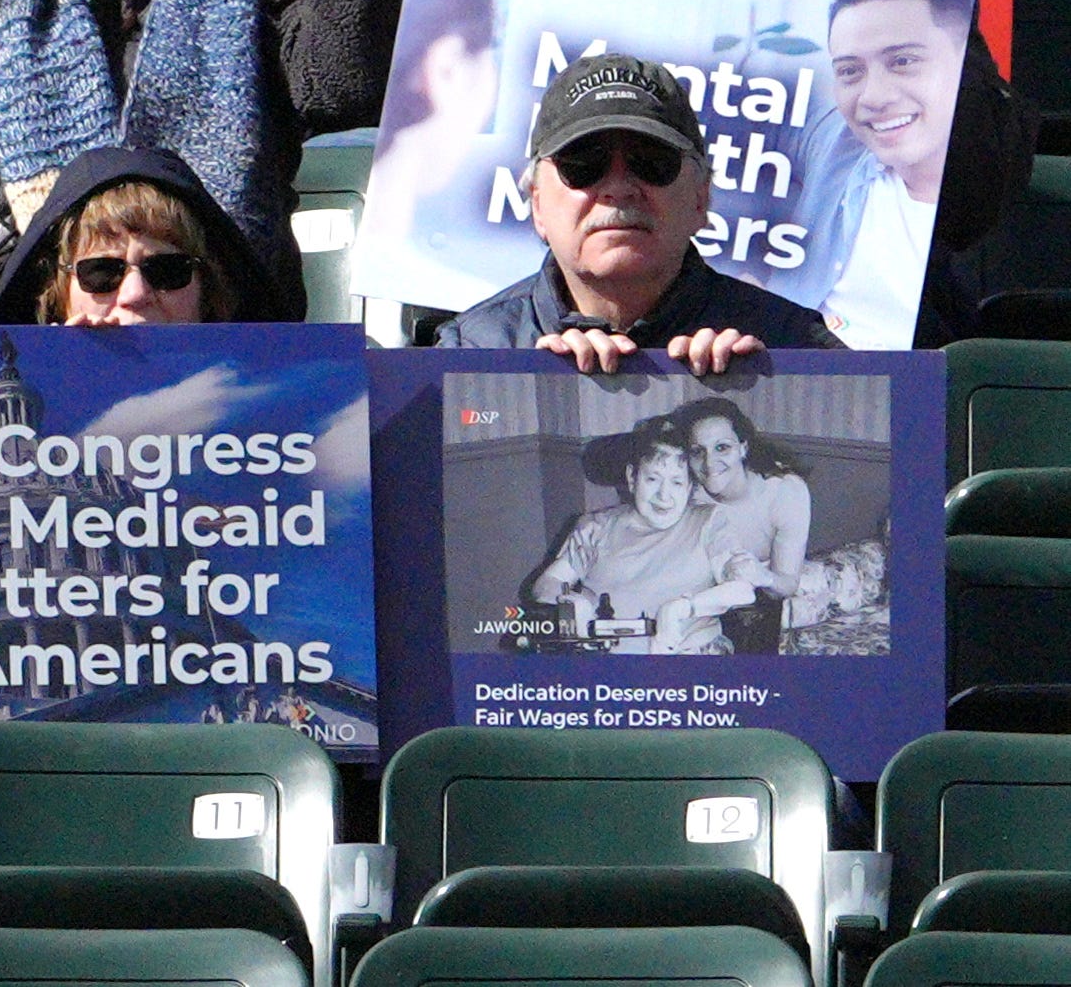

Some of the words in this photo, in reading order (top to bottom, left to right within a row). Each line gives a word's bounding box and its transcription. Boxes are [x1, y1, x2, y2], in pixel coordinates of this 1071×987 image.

[532, 31, 814, 128] Mntal
[487, 166, 808, 269] Mers
[468, 411, 500, 424] DSP
[11, 489, 326, 548] Medicaid
[181, 560, 279, 617] for
[473, 620, 555, 634] JAWONIO
[475, 684, 590, 702] Dedication
[595, 685, 688, 702] Deserves
[693, 685, 768, 706] Dignity
[296, 723, 356, 742] ONIO
[475, 709, 513, 726] Fair
[518, 709, 589, 730] Wages
[594, 709, 623, 727] for
[629, 710, 681, 727] DSPs
[687, 710, 740, 727] Now.
[211, 801, 243, 830] 11
[702, 805, 741, 835] 12
